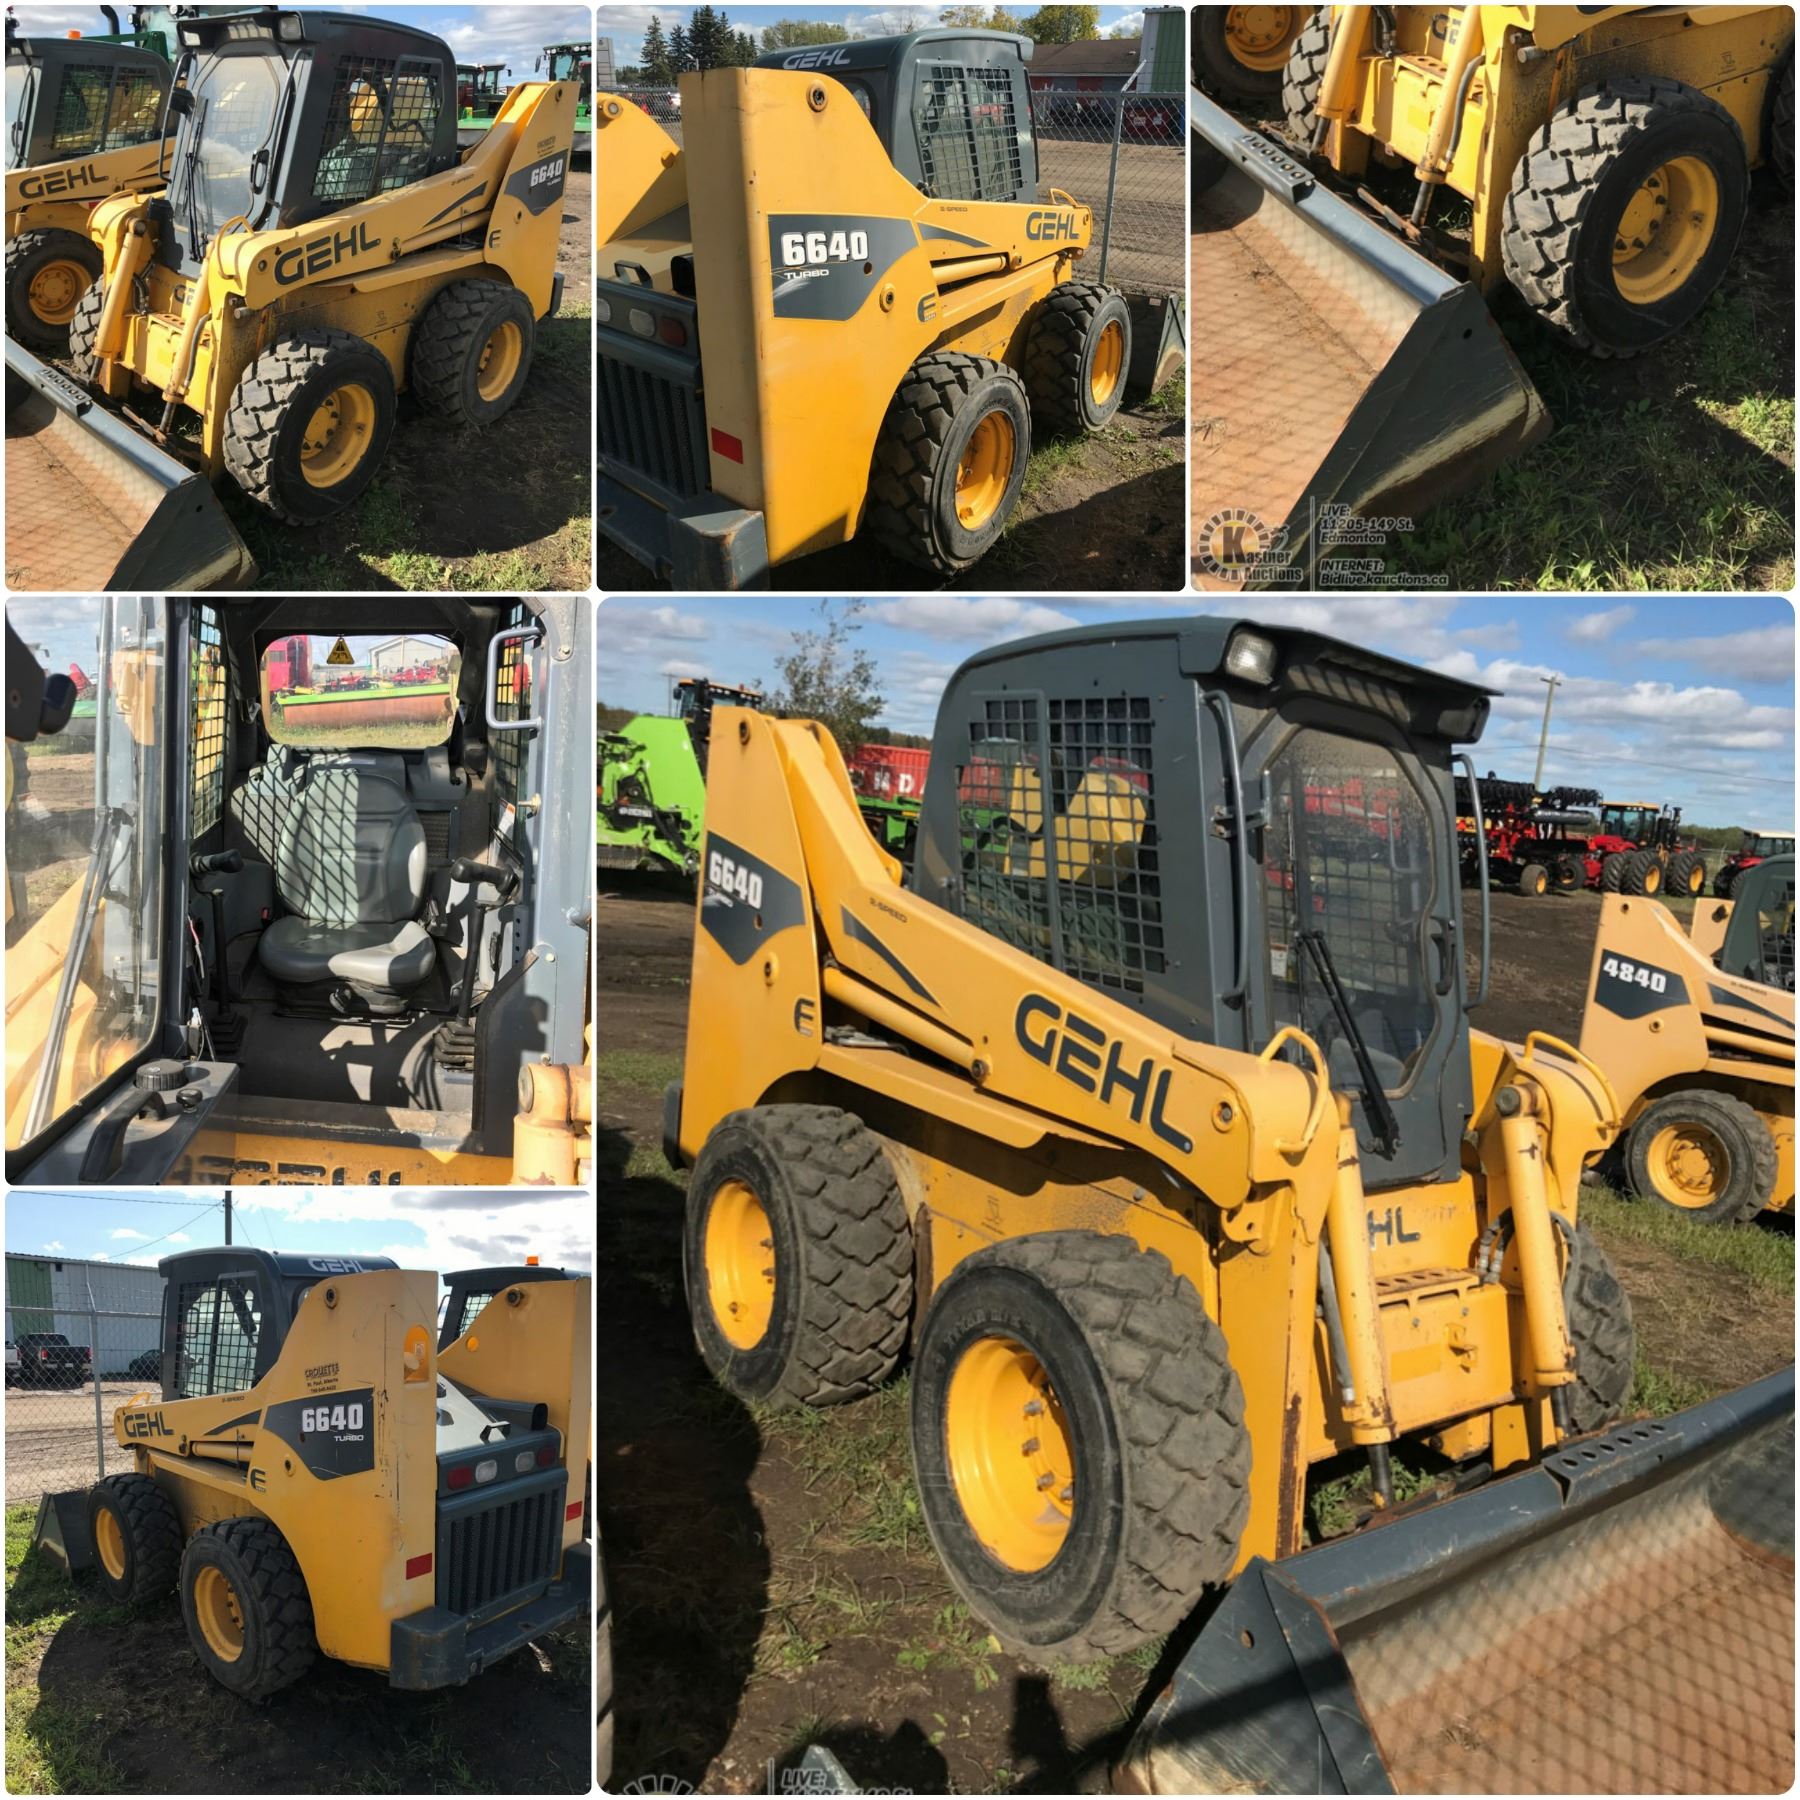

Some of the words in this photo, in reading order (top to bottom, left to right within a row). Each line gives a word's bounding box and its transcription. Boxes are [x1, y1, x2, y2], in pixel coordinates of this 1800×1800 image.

[783, 48, 850, 69] GEHL
[19, 163, 109, 199] GEHL
[530, 159, 563, 187] 6640
[1026, 211, 1079, 240] GEHL
[274, 221, 381, 285] GEHL
[781, 230, 868, 266] 6640
[784, 269, 829, 280] TURBO
[710, 850, 763, 909] 6640
[1603, 958, 1667, 994] 4840
[1015, 993, 1193, 1155] GEHL
[124, 1411, 175, 1438] GEHL
[302, 1404, 364, 1433] 6640
